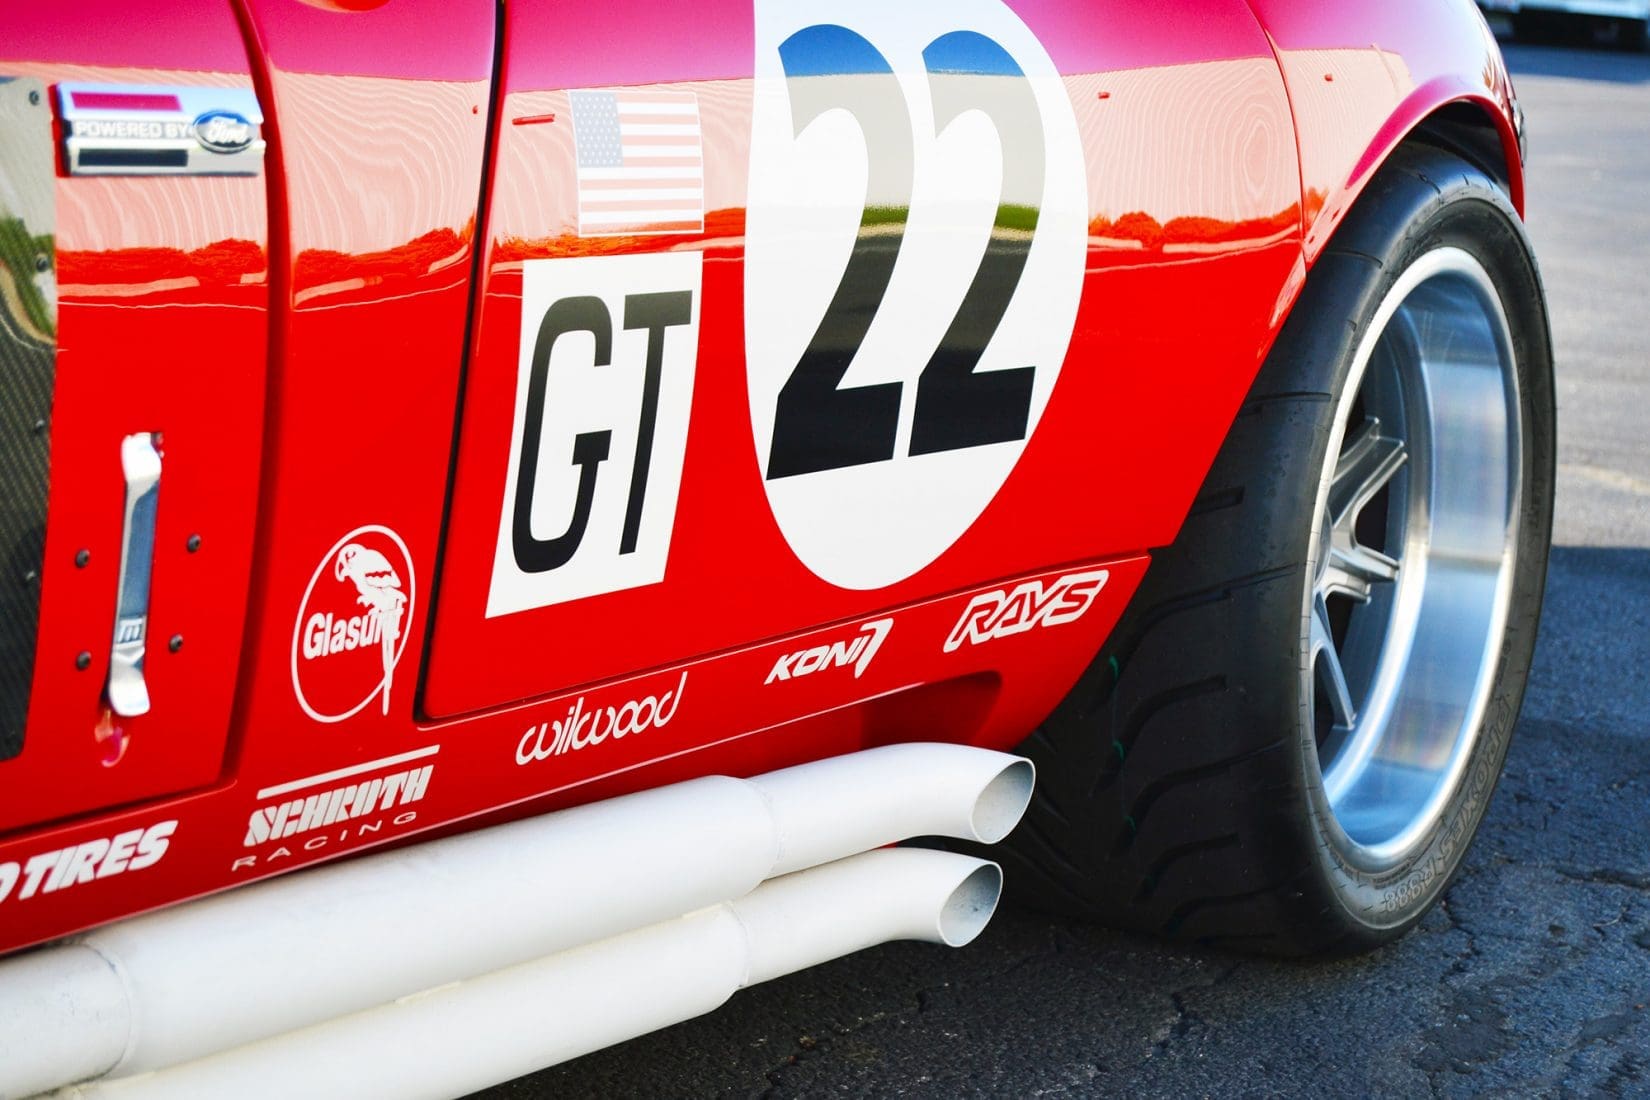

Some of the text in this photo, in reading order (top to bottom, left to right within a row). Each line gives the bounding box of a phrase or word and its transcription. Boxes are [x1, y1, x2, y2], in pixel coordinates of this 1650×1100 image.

[76, 116, 250, 144] POWERED BY Ford
[766, 23, 1046, 480] 22
[511, 290, 693, 574] GT
[943, 570, 1110, 653] RAYS
[515, 672, 688, 766] wilwood
[231, 811, 417, 872] RACING
[243, 764, 434, 847] SCHROTH
[18, 820, 179, 901] TIRES
